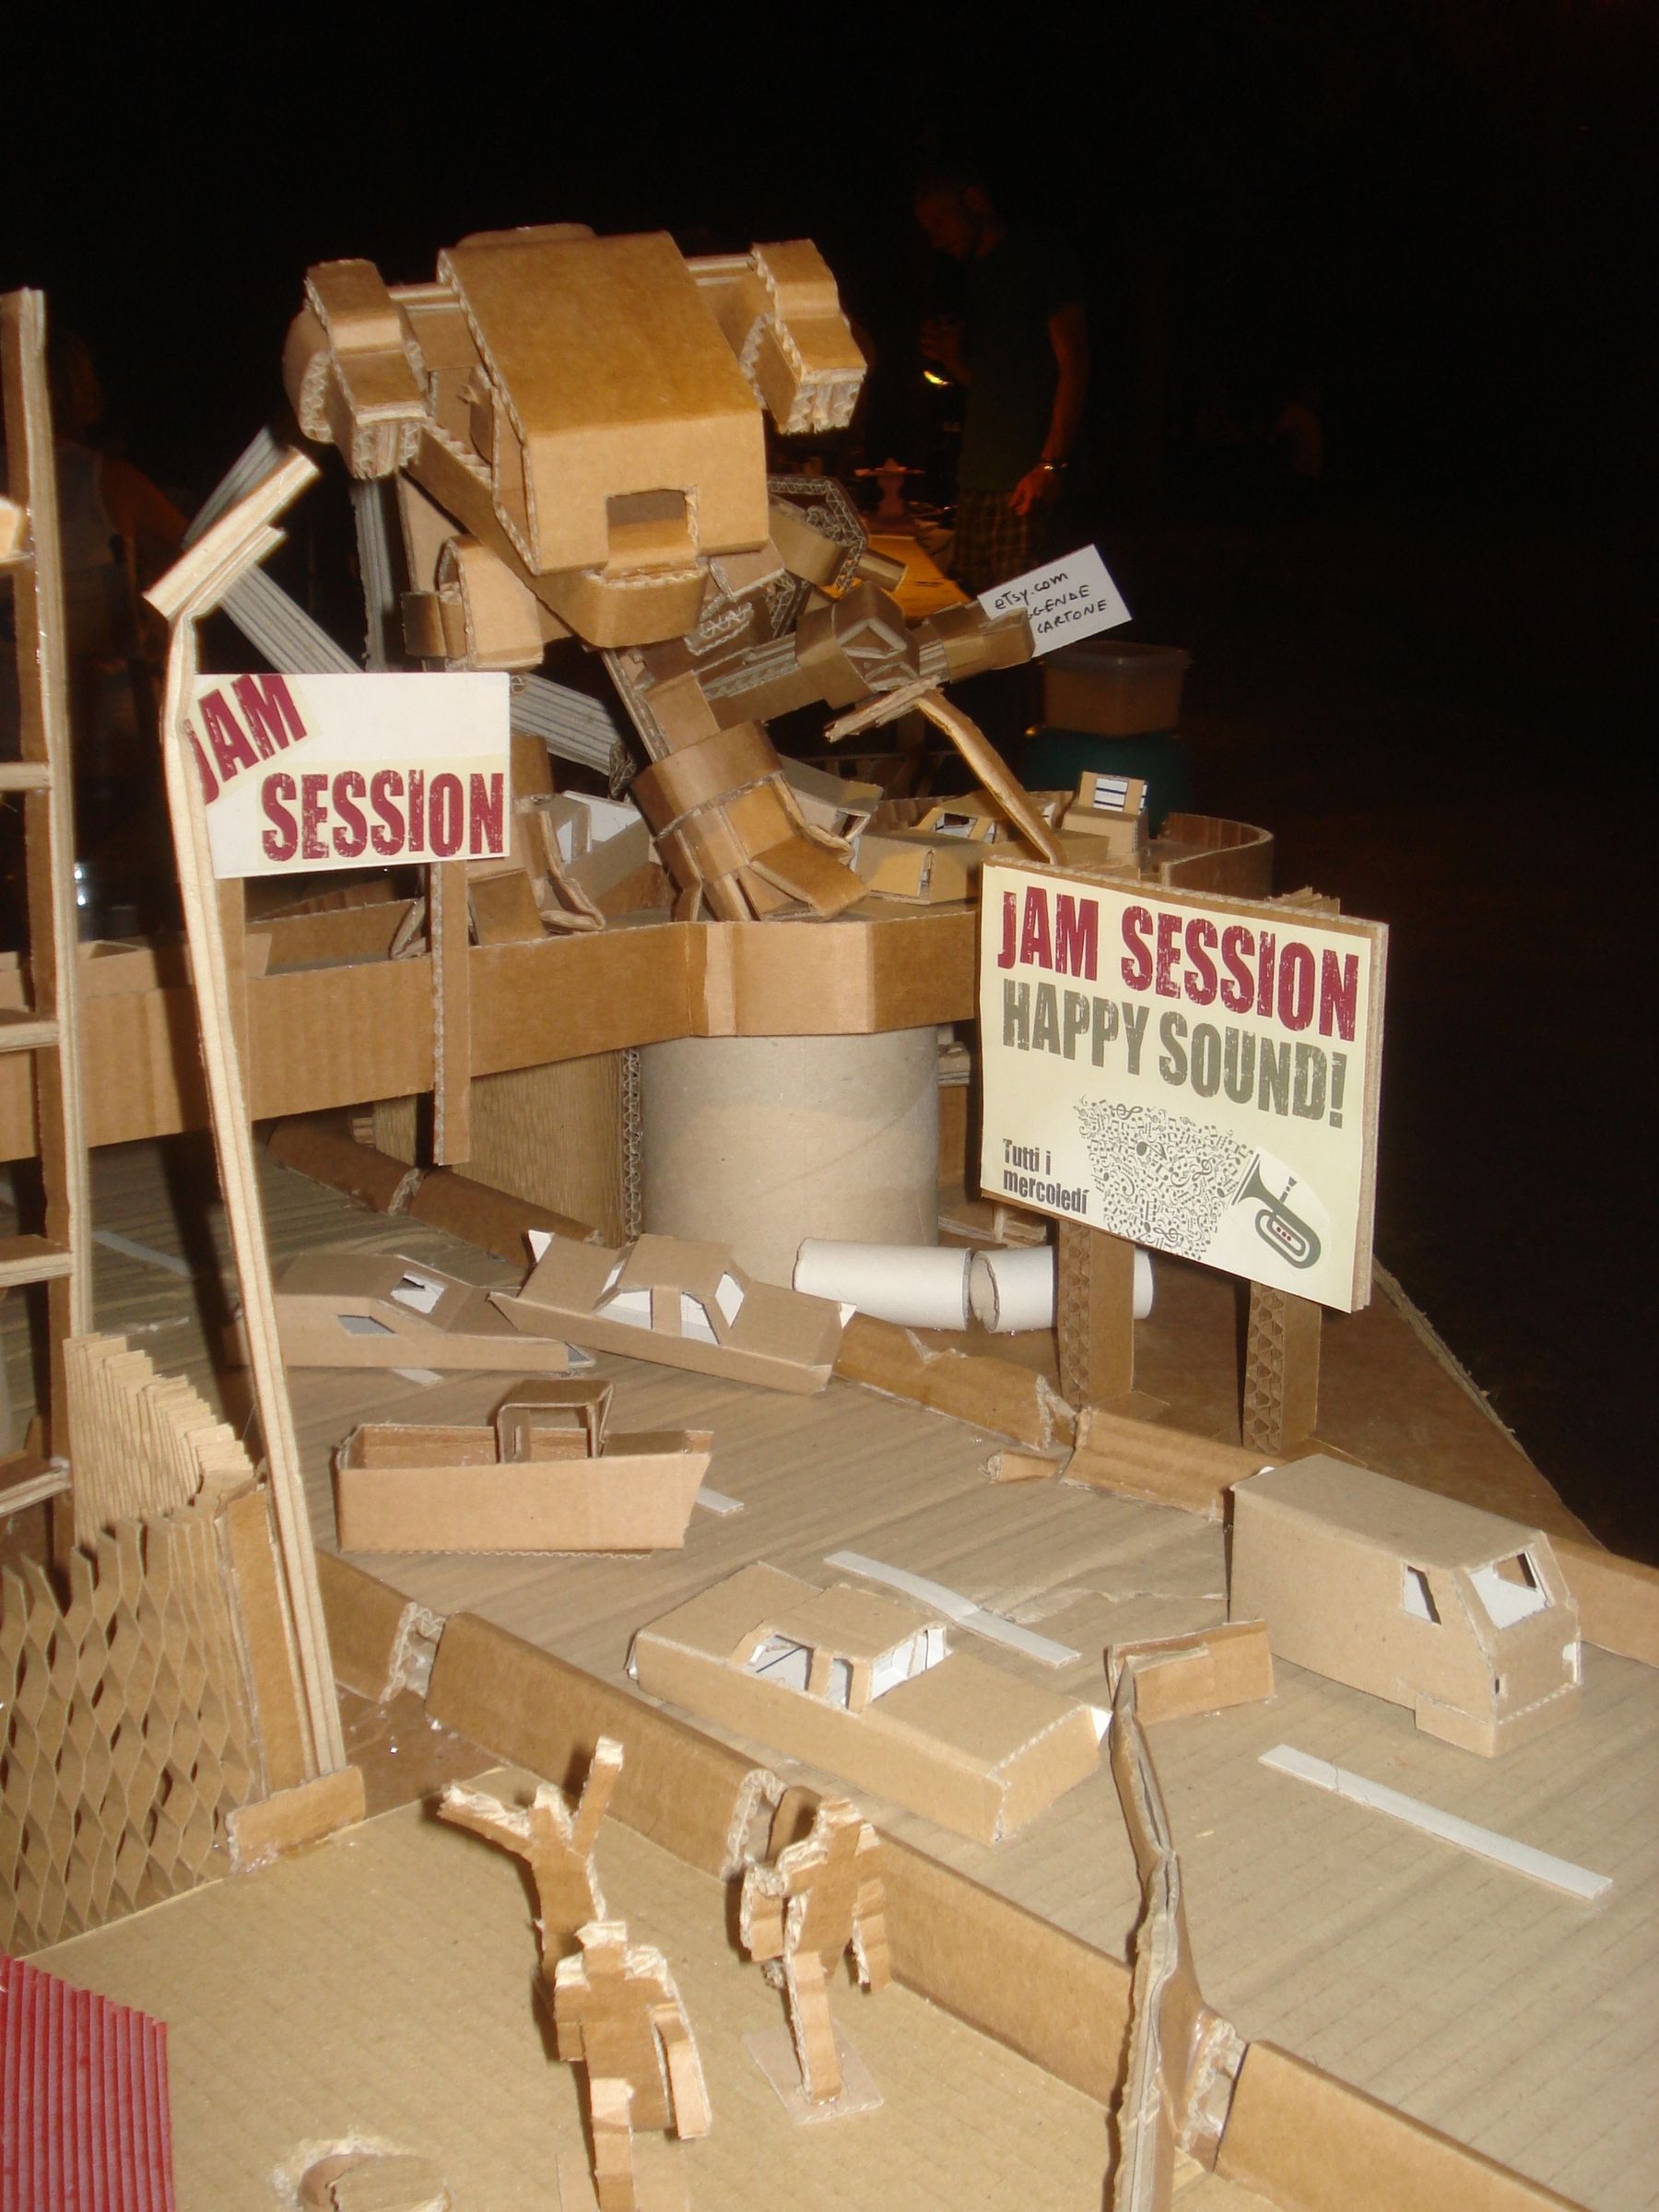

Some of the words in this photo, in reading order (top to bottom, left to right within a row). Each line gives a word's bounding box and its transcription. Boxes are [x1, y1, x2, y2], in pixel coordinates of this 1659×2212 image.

[1038, 600, 1106, 633] CARTONE
[184, 674, 307, 805] JAM
[261, 769, 504, 862] SESSION
[997, 887, 1099, 981] JAM
[1121, 905, 1359, 1041] SESSION
[1003, 979, 1150, 1076] HAPPY
[1159, 1011, 1347, 1128] SOUND!
[1004, 1139, 1040, 1172] Tutti
[1045, 1150, 1052, 1175] i
